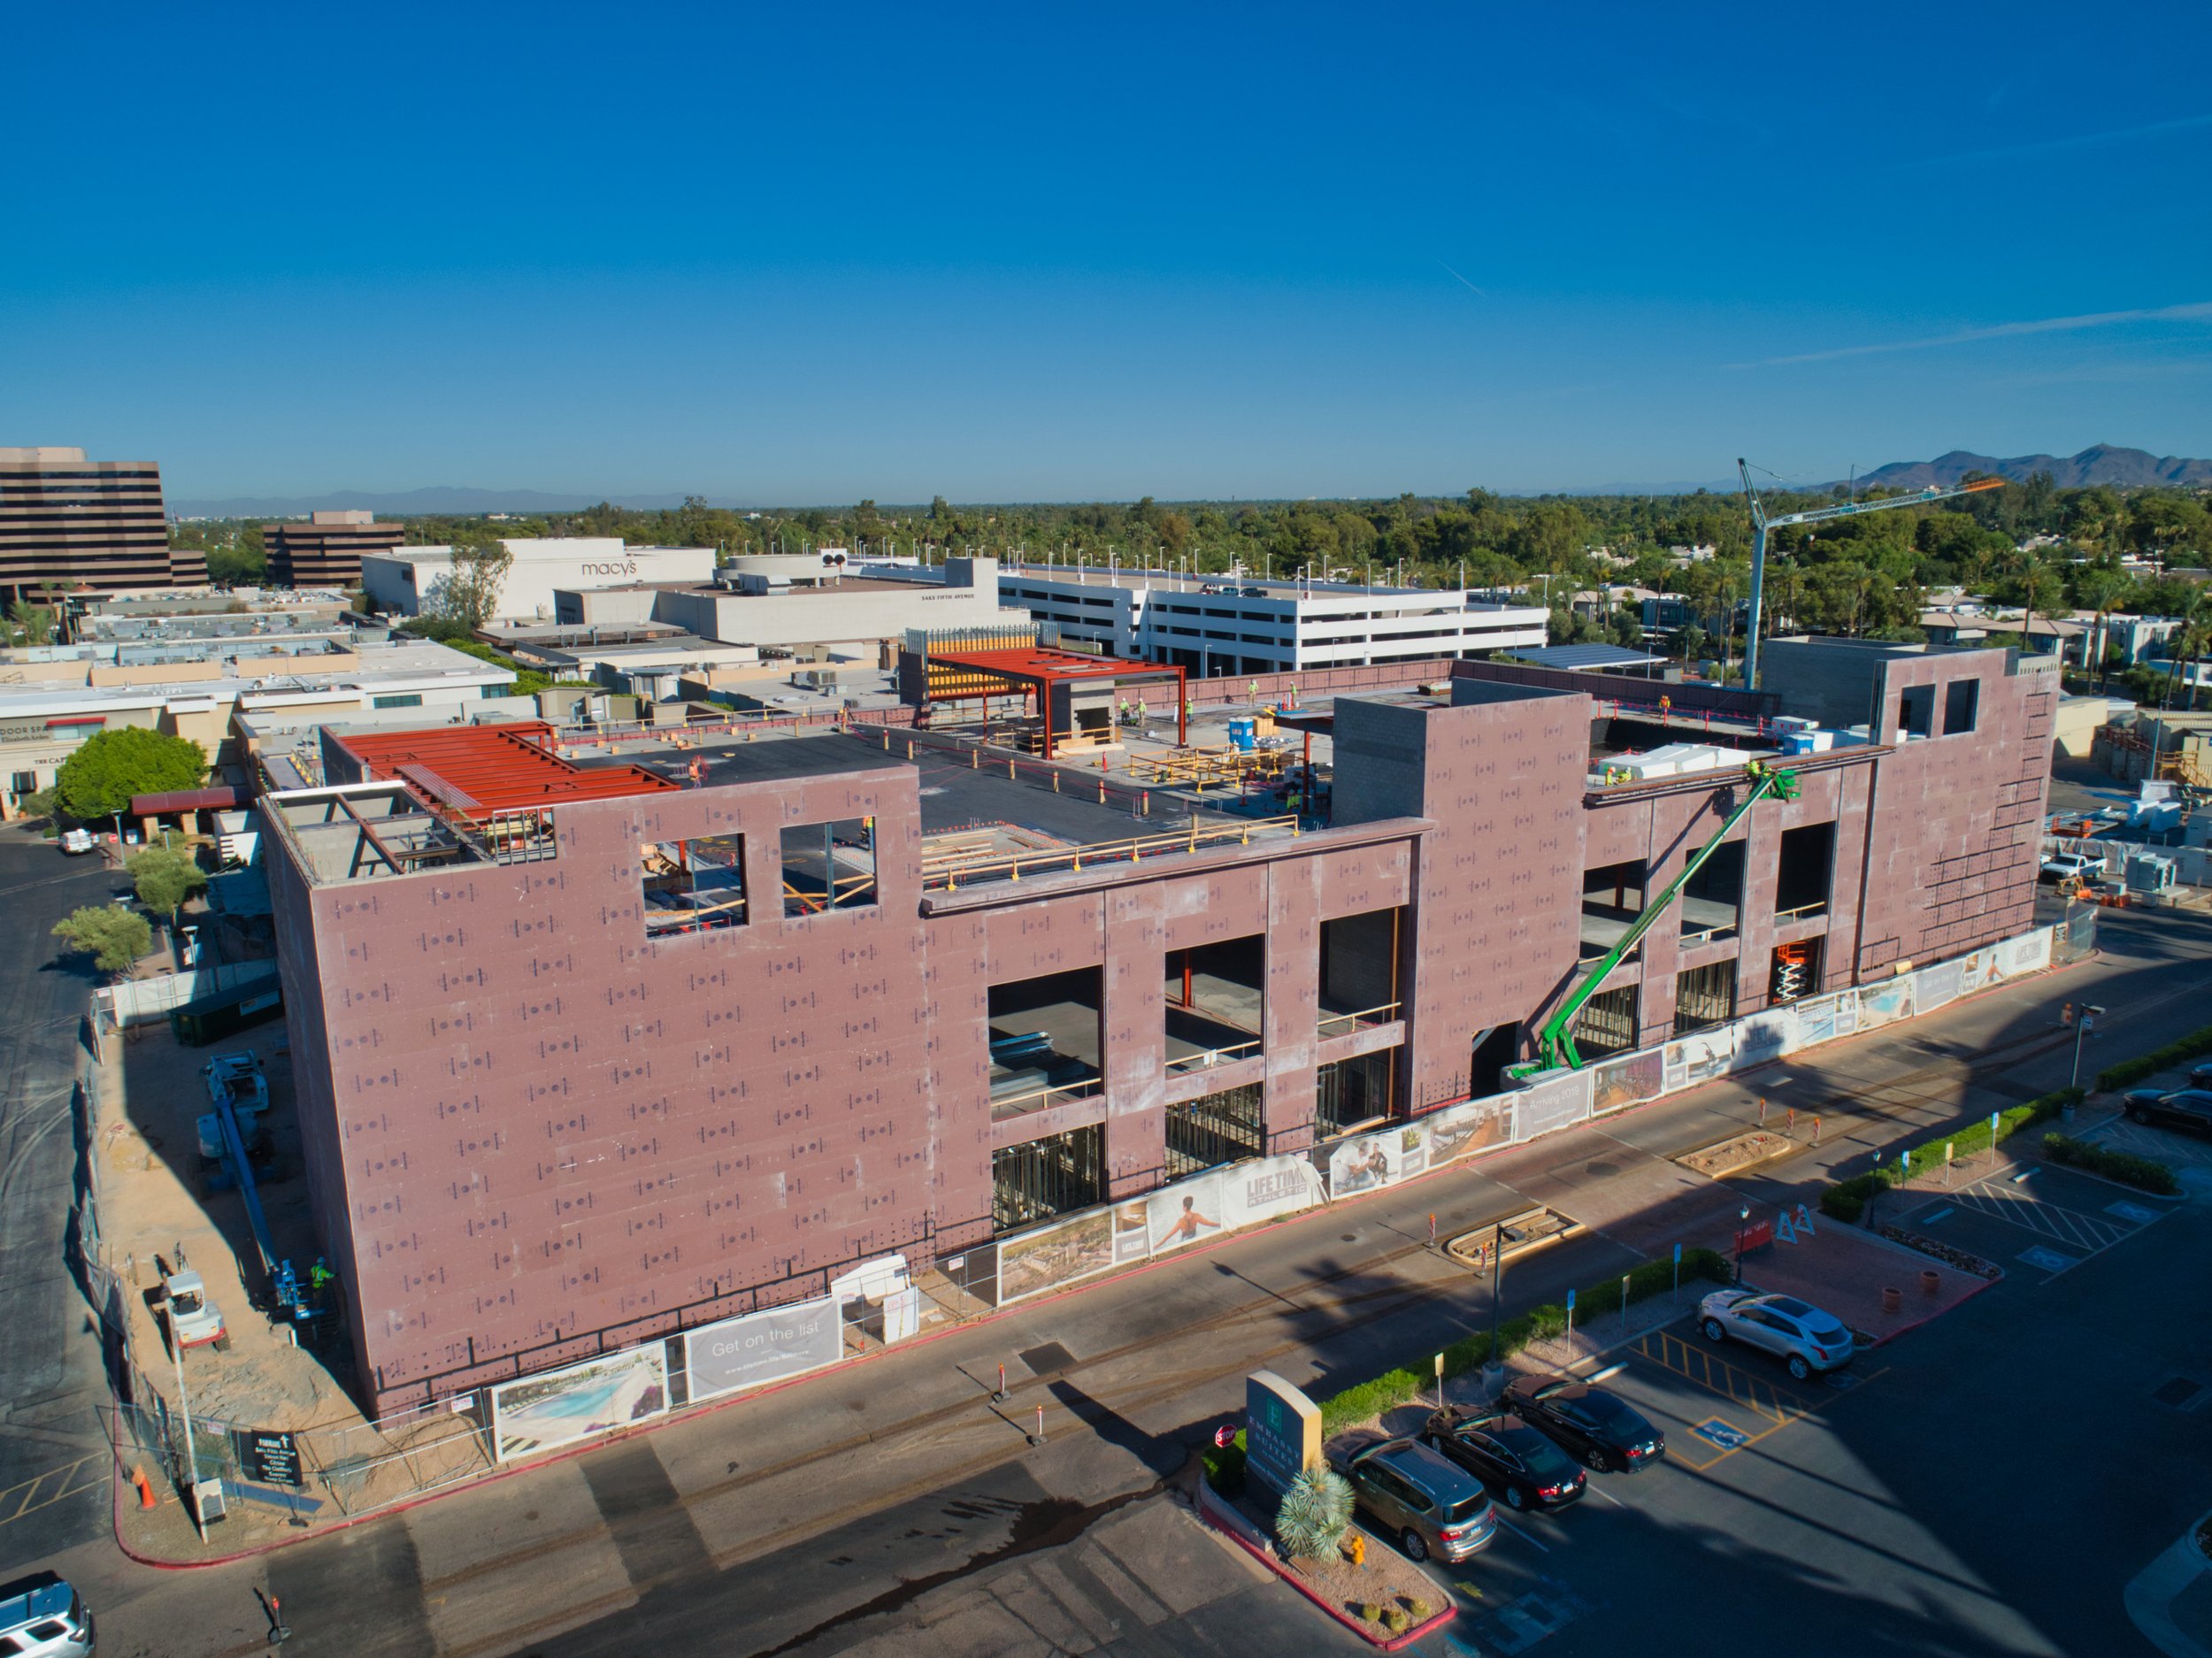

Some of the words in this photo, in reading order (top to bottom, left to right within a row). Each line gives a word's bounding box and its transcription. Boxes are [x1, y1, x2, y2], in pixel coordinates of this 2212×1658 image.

[581, 560, 637, 578] macy's
[1, 734, 30, 743] Elizabeth
[1530, 1093, 1560, 1109] Arriving
[1562, 1085, 1579, 1100] 2019
[1247, 1174, 1273, 1198] LIFE
[1248, 1185, 1307, 1206] ATHLETIC
[712, 1339, 741, 1357] Get
[745, 1333, 764, 1348] on
[769, 1327, 794, 1342] the
[799, 1321, 819, 1337] list
[1217, 1430, 1235, 1442] STOP
[1248, 1416, 1301, 1460] EMBASSY
[1255, 1432, 1294, 1467] SUITES
